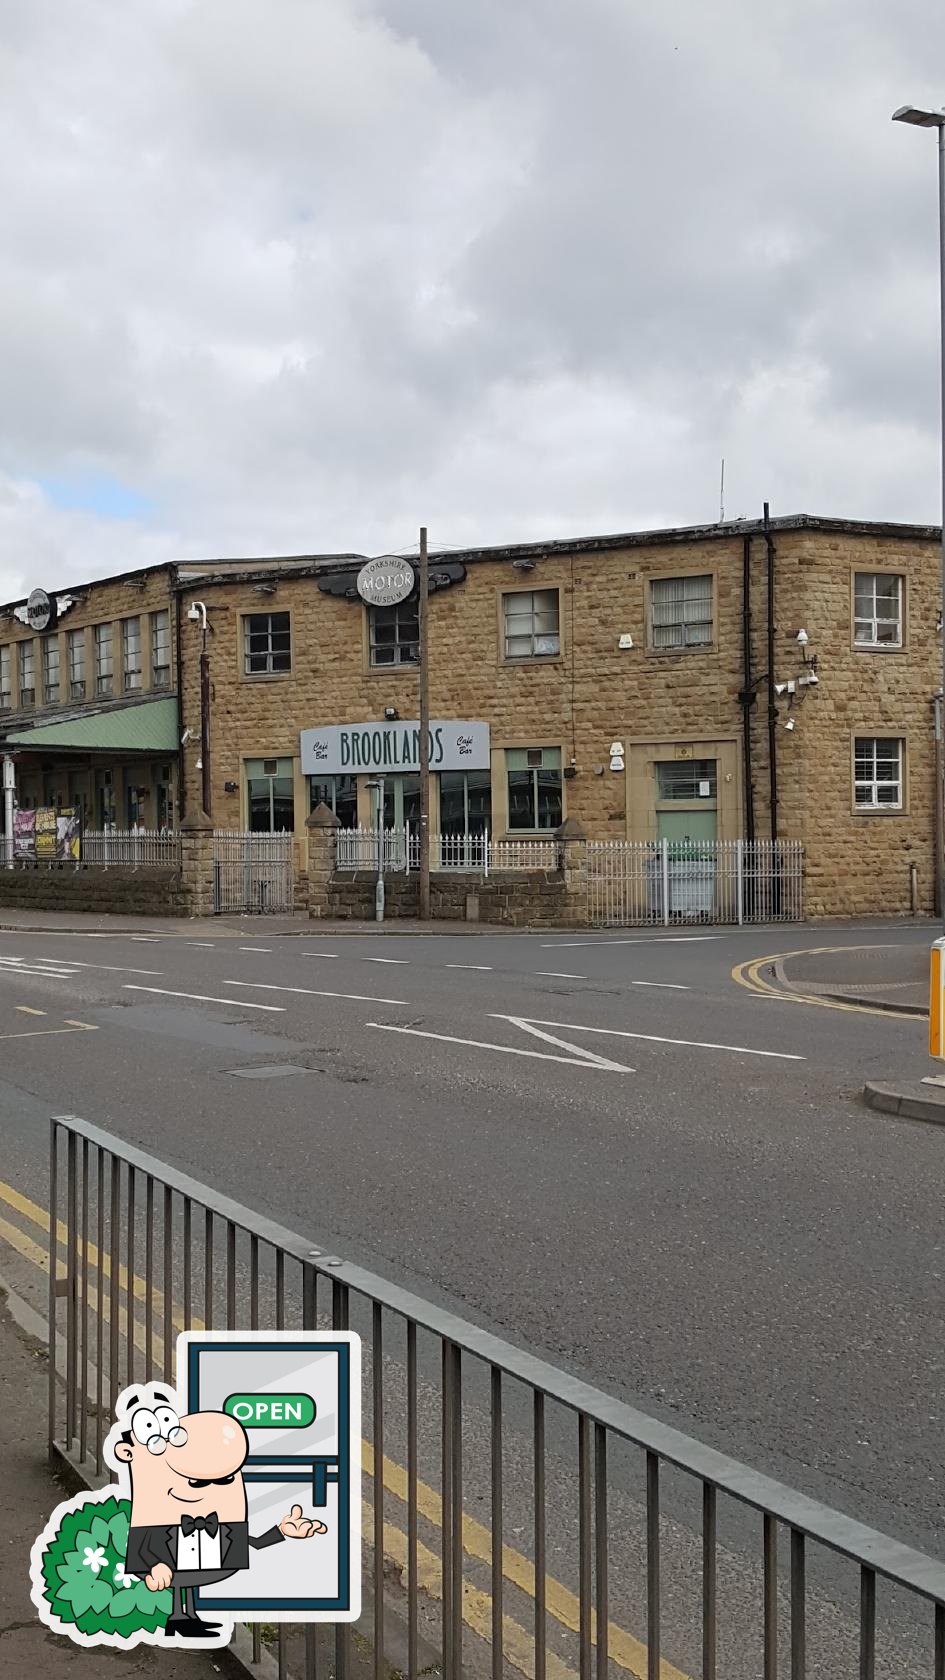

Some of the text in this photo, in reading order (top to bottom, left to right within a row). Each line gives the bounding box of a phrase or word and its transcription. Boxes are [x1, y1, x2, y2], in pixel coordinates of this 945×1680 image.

[365, 560, 406, 575] YORKSHIRE
[362, 572, 412, 592] MOTOR
[371, 592, 403, 604] MUSEUM
[340, 728, 444, 766] BROOKLANDS
[456, 735, 474, 747] Café
[315, 751, 328, 760] Bar
[459, 746, 473, 755] Bar
